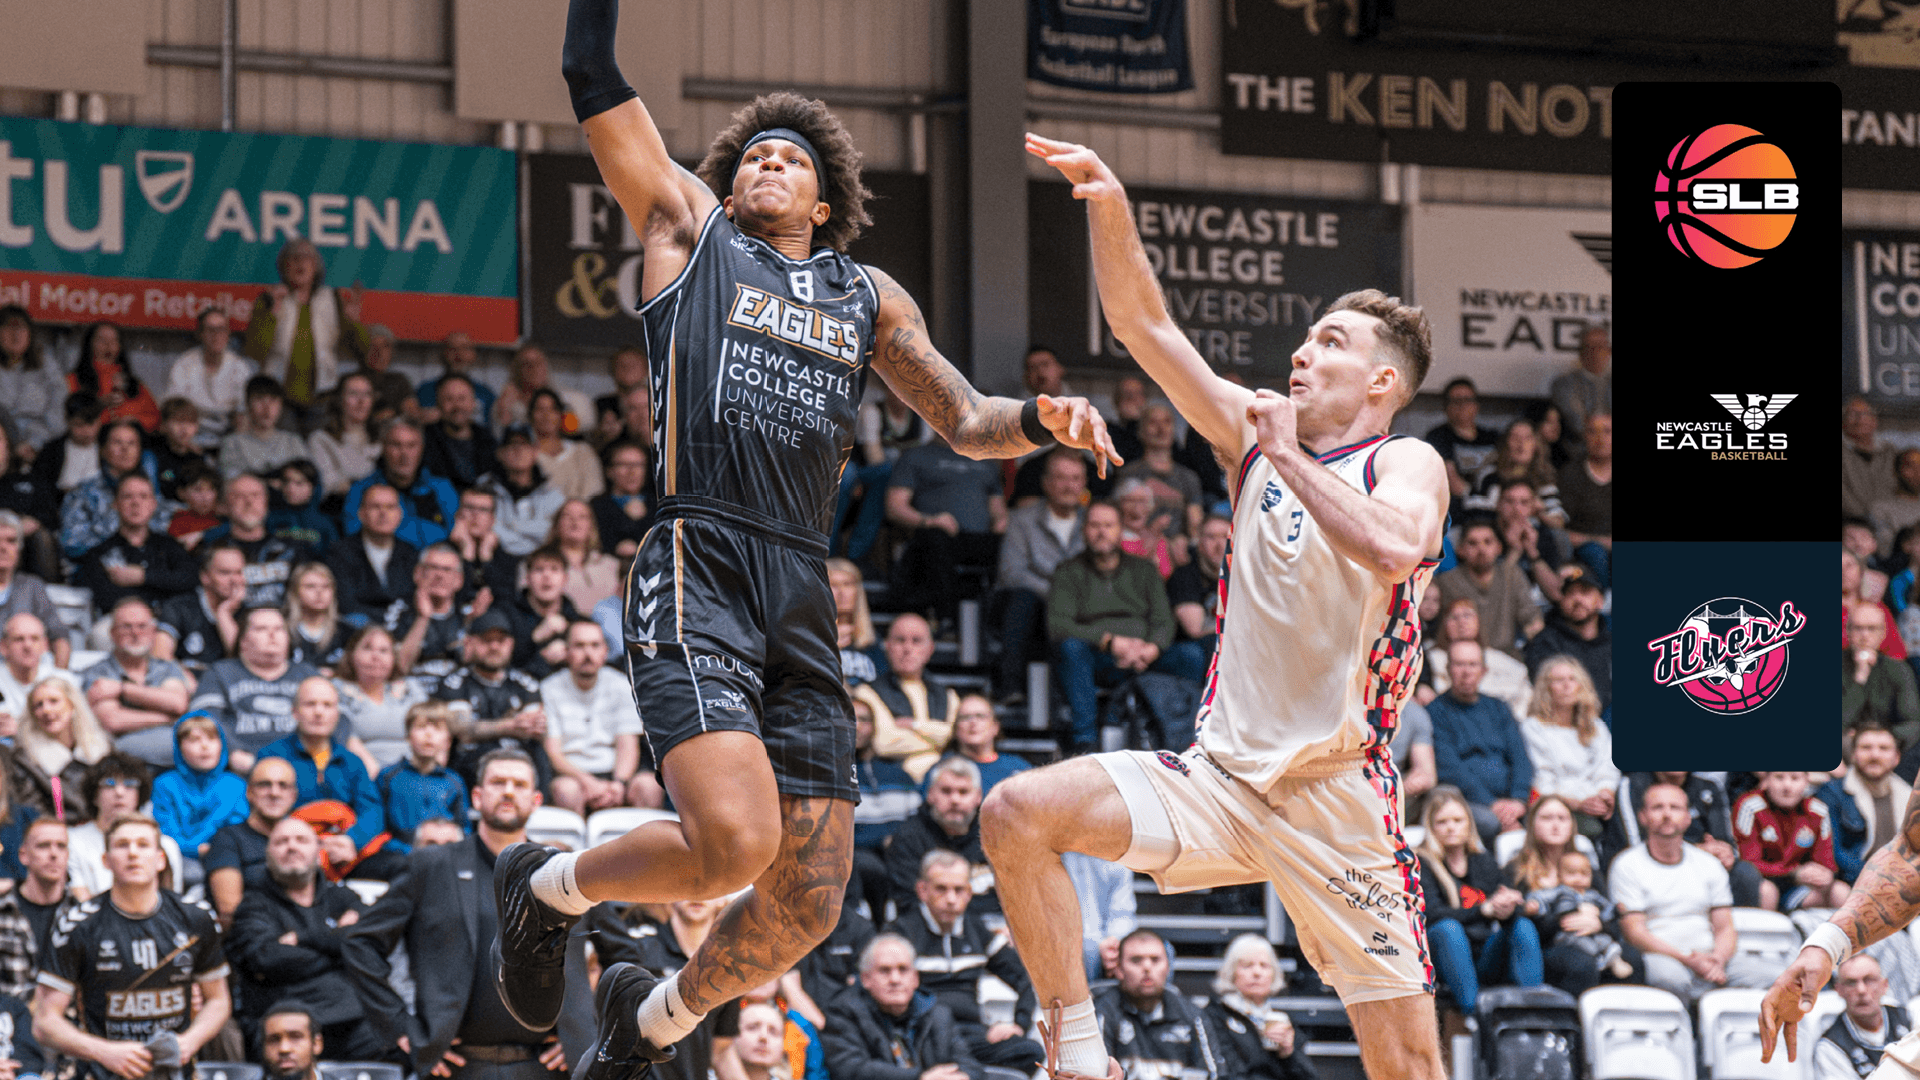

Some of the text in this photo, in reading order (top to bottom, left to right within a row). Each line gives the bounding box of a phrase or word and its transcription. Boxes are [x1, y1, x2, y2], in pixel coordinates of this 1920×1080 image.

[1227, 73, 1315, 112] THE
[1327, 72, 1467, 131] KEN
[1842, 108, 1920, 147] TAN
[205, 189, 453, 253] ARENA
[1128, 200, 1340, 249] EWCASTLE
[1143, 242, 1284, 286] OLLEGE
[40, 281, 134, 315] Motor
[790, 270, 814, 303] 8
[1460, 287, 1611, 316] NEWCASTLE
[731, 287, 859, 364] EAGLES
[728, 363, 827, 411] COLLEGE
[732, 341, 852, 400] NEWCASTLE
[723, 407, 804, 449] CENTRE
[726, 384, 839, 438] UNIVERSITY
[1287, 510, 1303, 542] 3
[1345, 868, 1372, 883] the
[1364, 945, 1400, 956] oneills
[108, 987, 185, 1018] EAGLES
